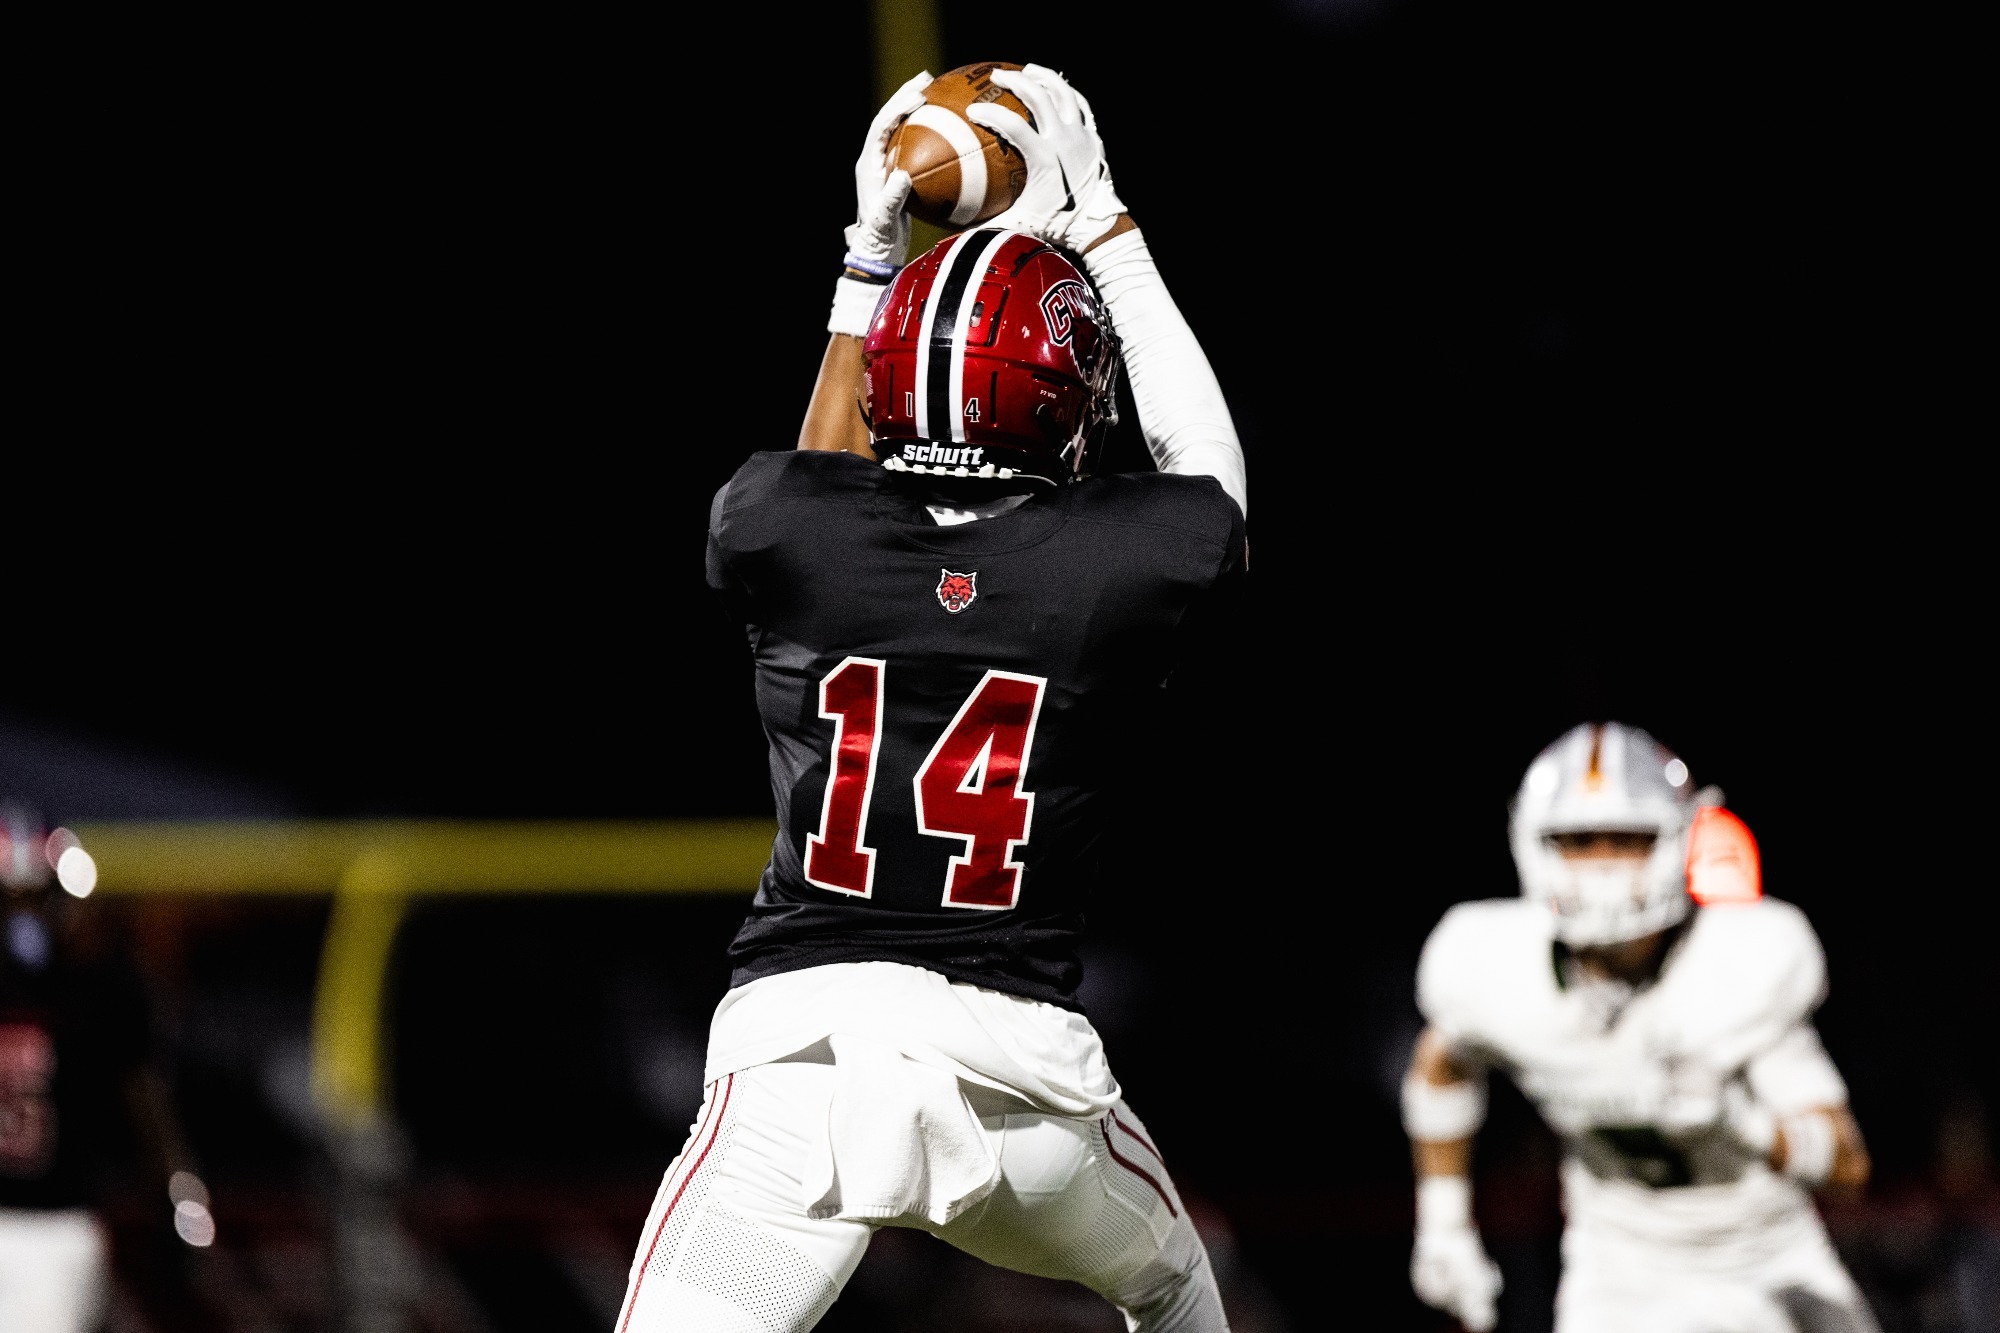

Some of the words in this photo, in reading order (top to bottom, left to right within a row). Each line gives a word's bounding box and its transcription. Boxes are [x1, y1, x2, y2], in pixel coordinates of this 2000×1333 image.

[964, 397, 981, 423] 4
[903, 441, 984, 465] schutt
[804, 655, 1048, 911] 14
